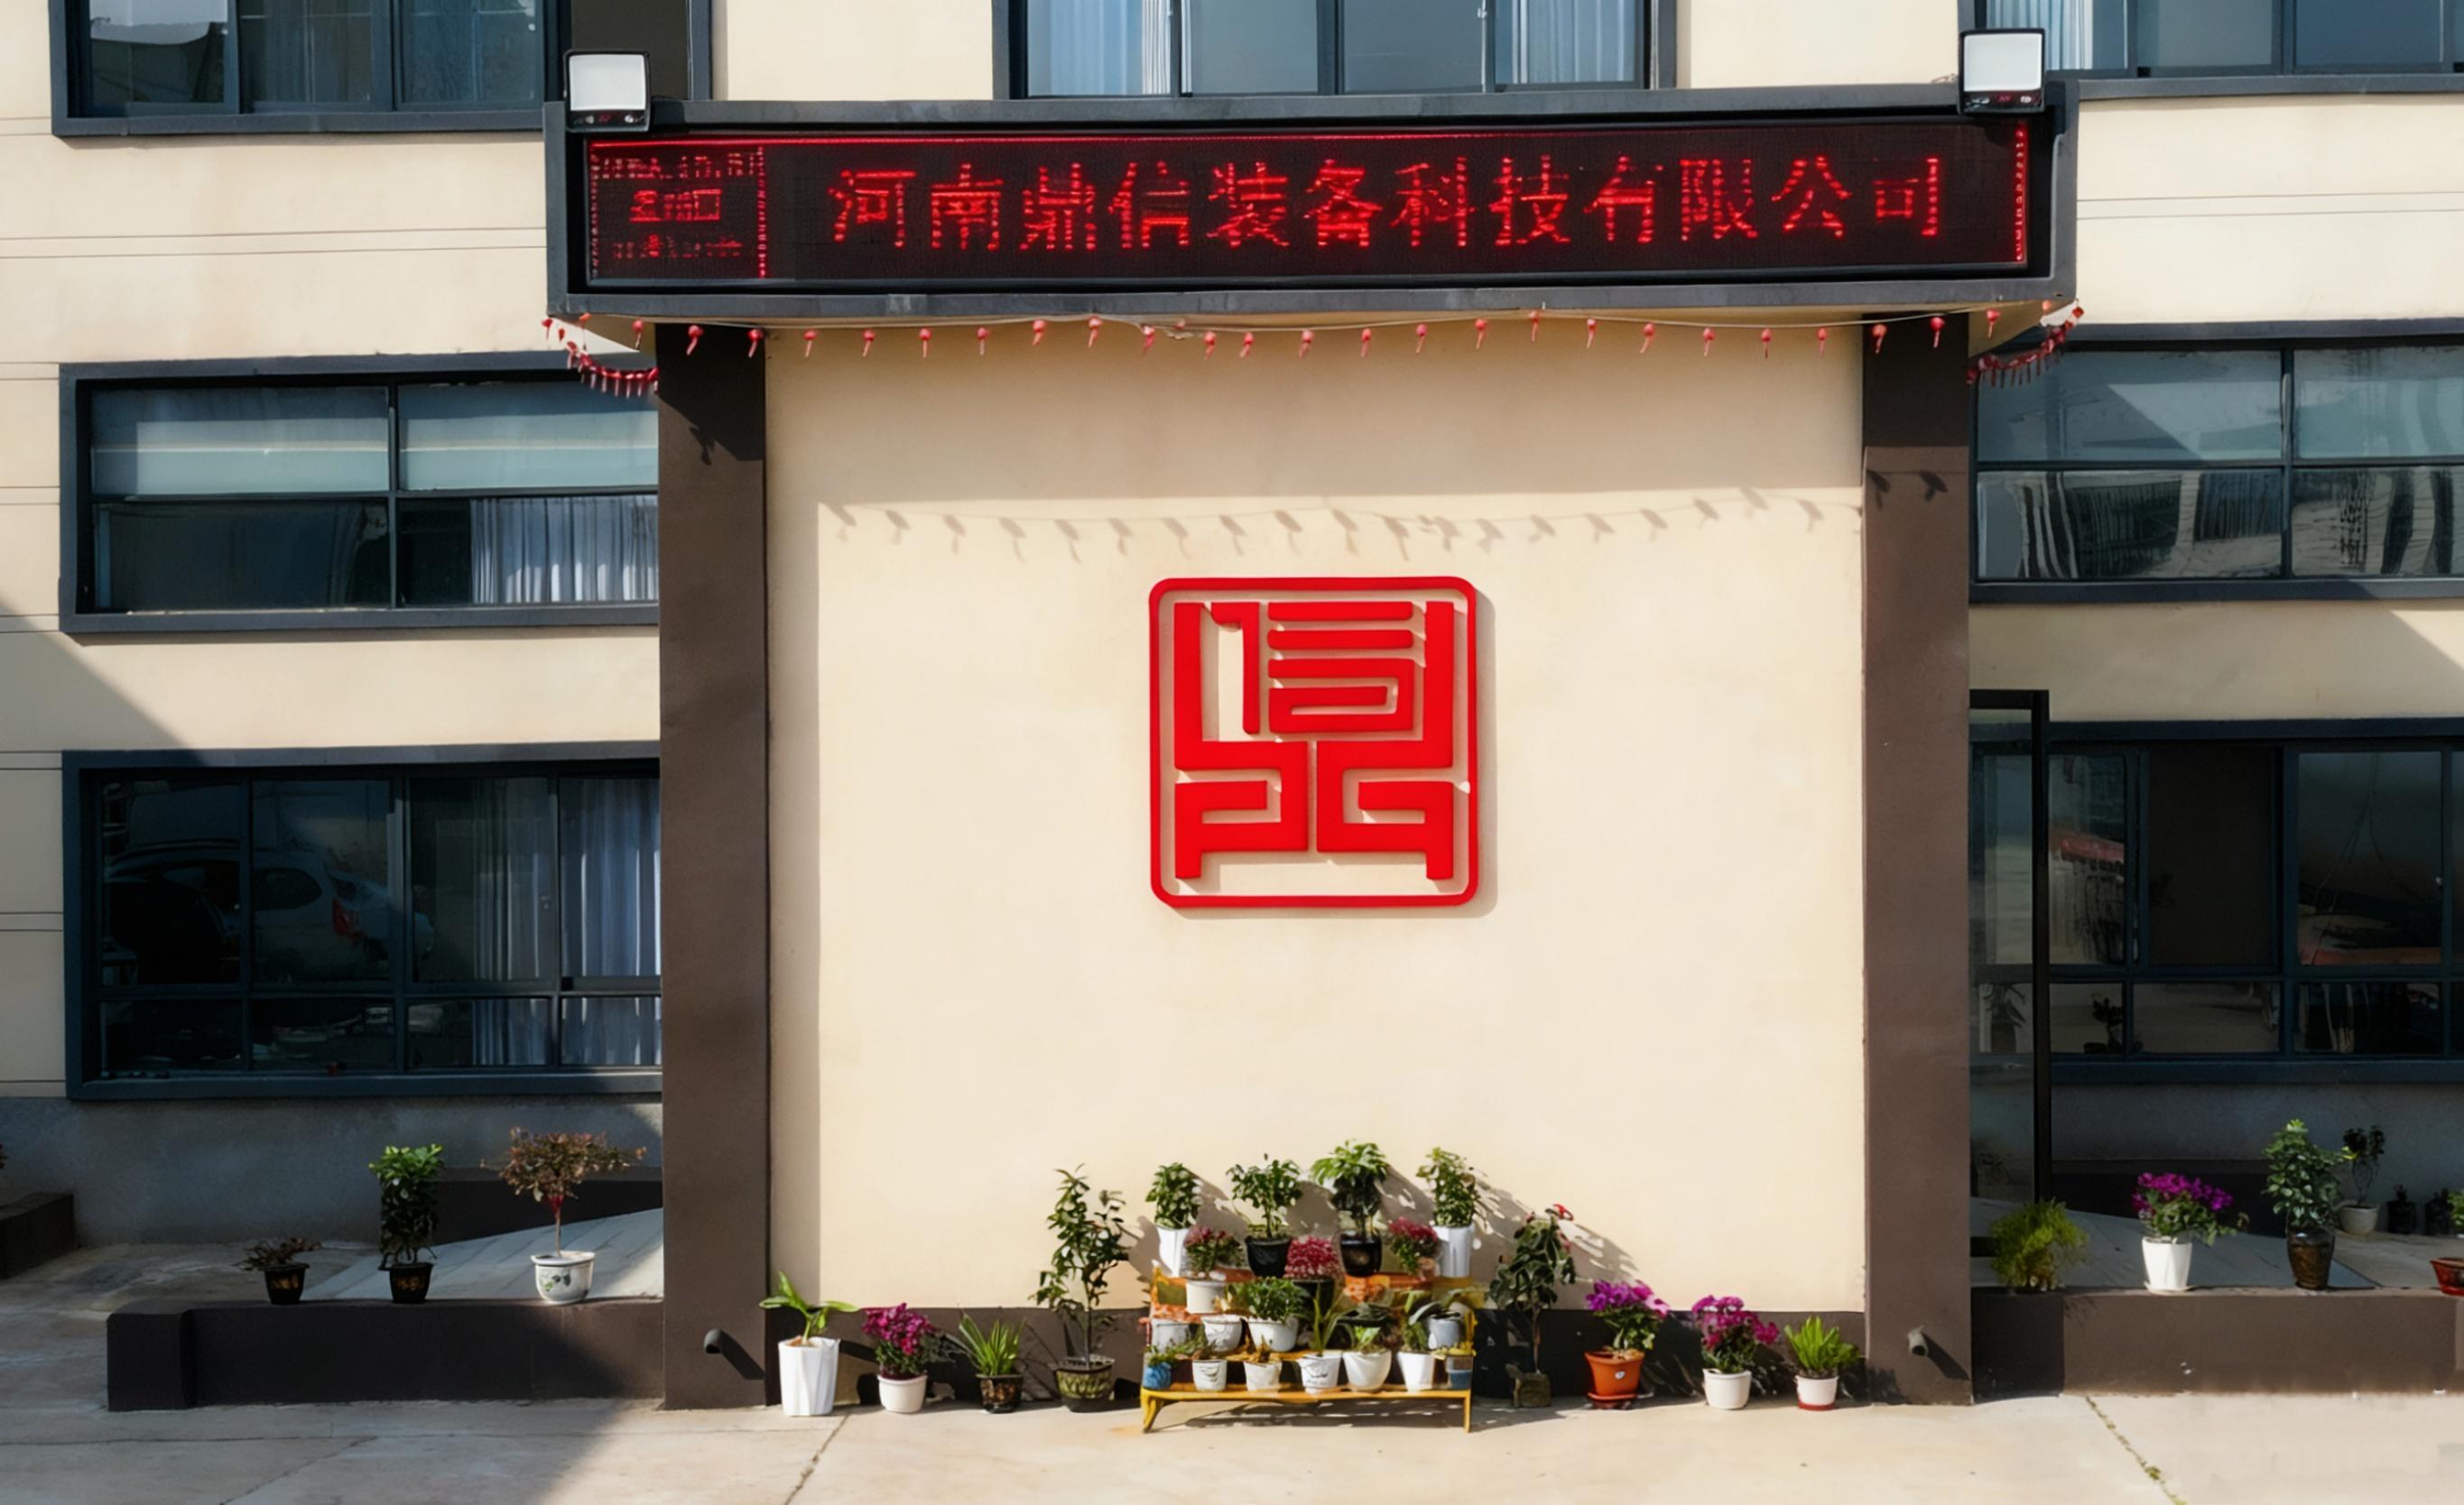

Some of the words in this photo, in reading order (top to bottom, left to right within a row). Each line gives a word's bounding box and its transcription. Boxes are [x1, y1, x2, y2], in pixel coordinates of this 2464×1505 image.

[828, 155, 1942, 252] 河南鼎信装备科技有限公司
